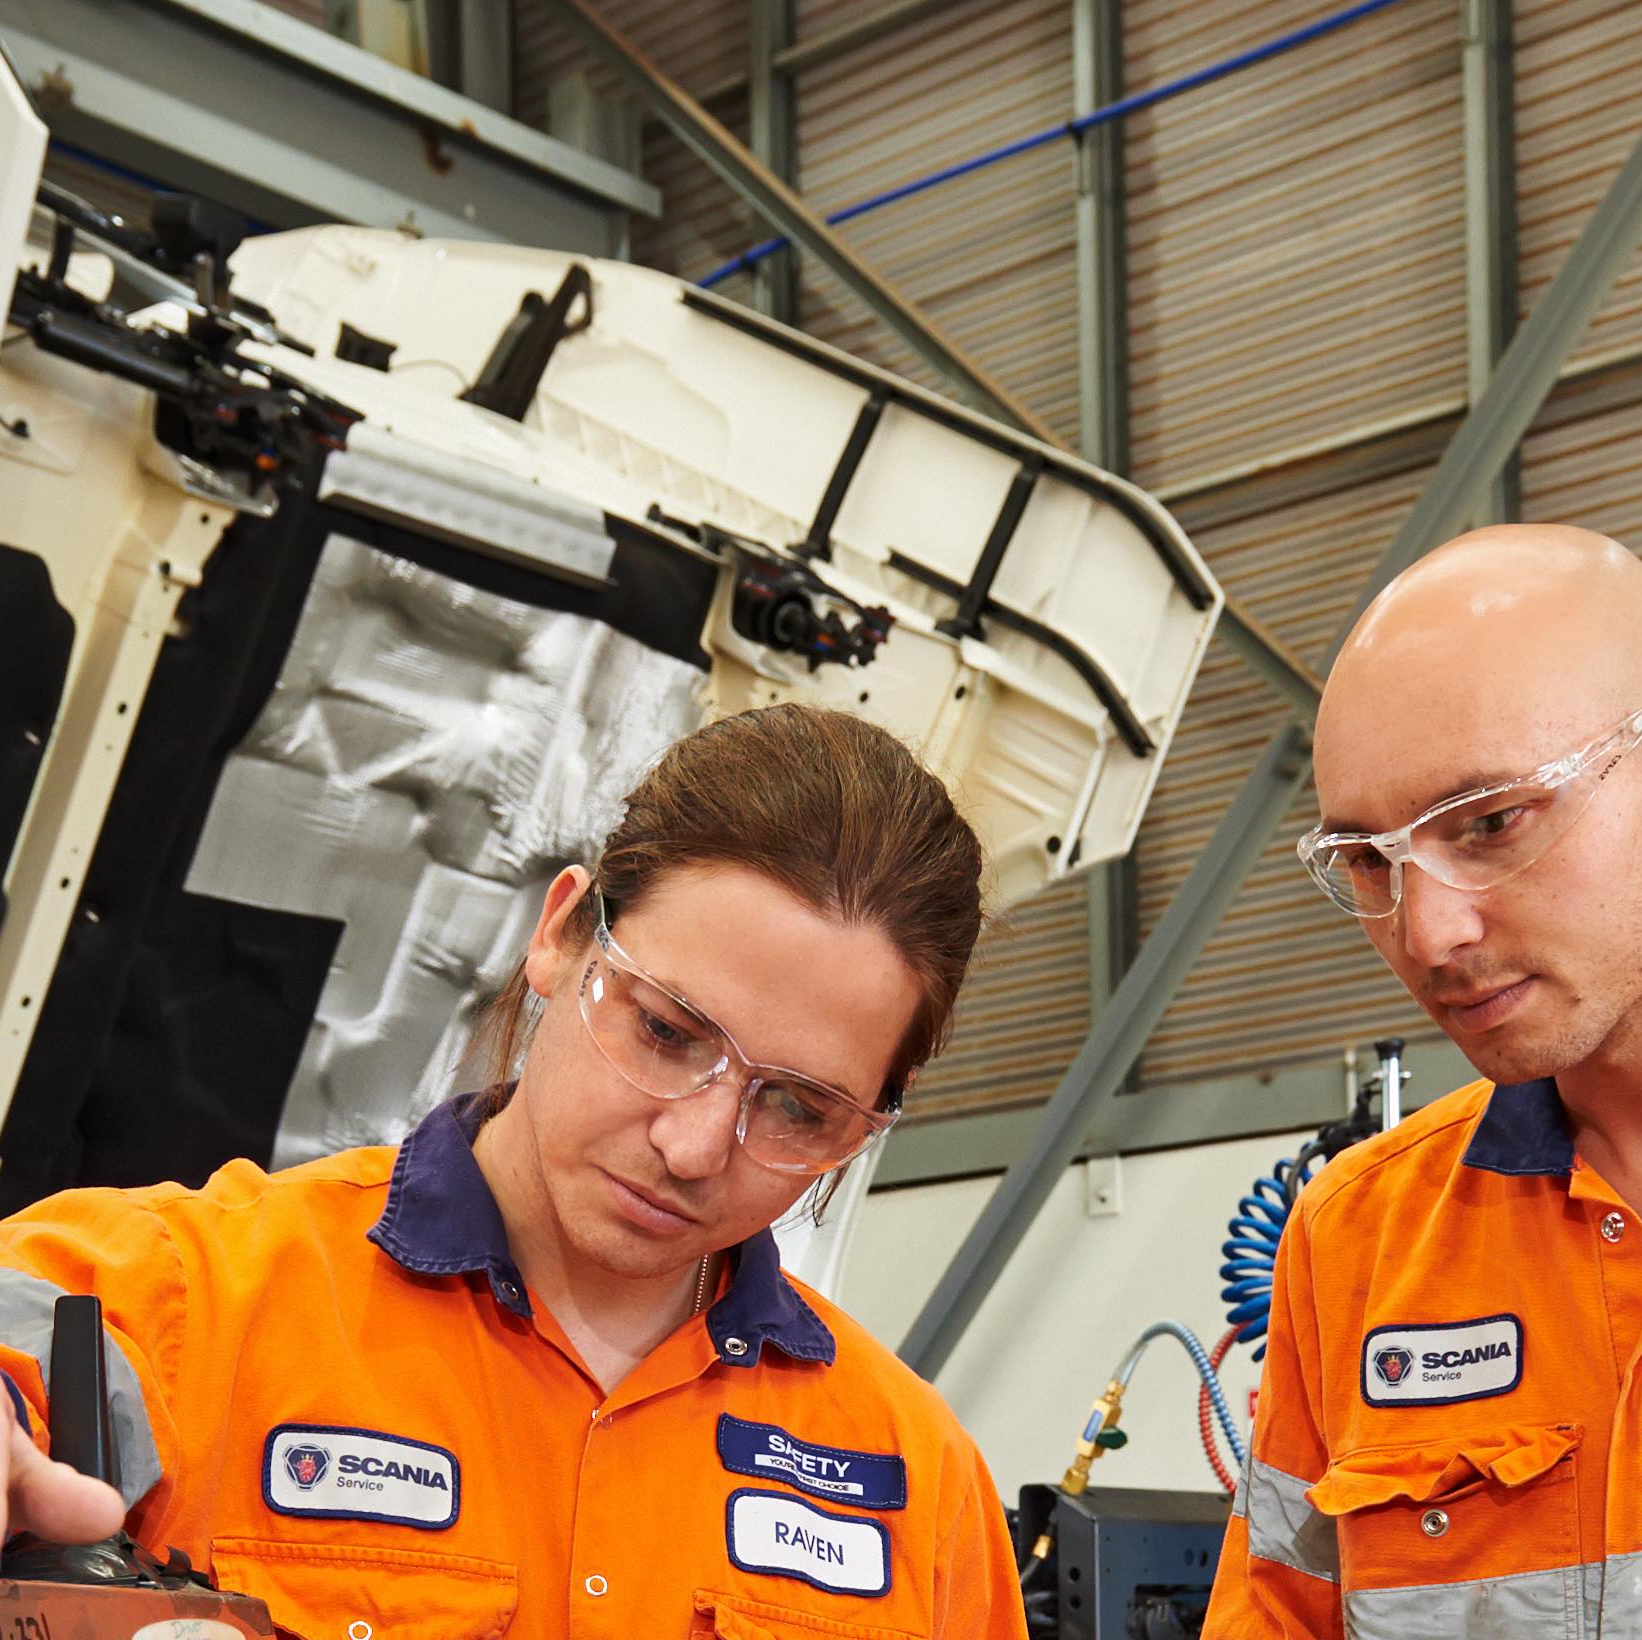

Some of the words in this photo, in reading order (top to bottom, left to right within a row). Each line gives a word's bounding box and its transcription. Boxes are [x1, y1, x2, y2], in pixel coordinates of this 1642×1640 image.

[1422, 1342, 1512, 1369] SCANIA
[1422, 1371, 1462, 1382] Service
[337, 1476, 384, 1491] Service
[338, 1455, 448, 1491] SCANIA
[775, 1521, 845, 1565] RAVEN
